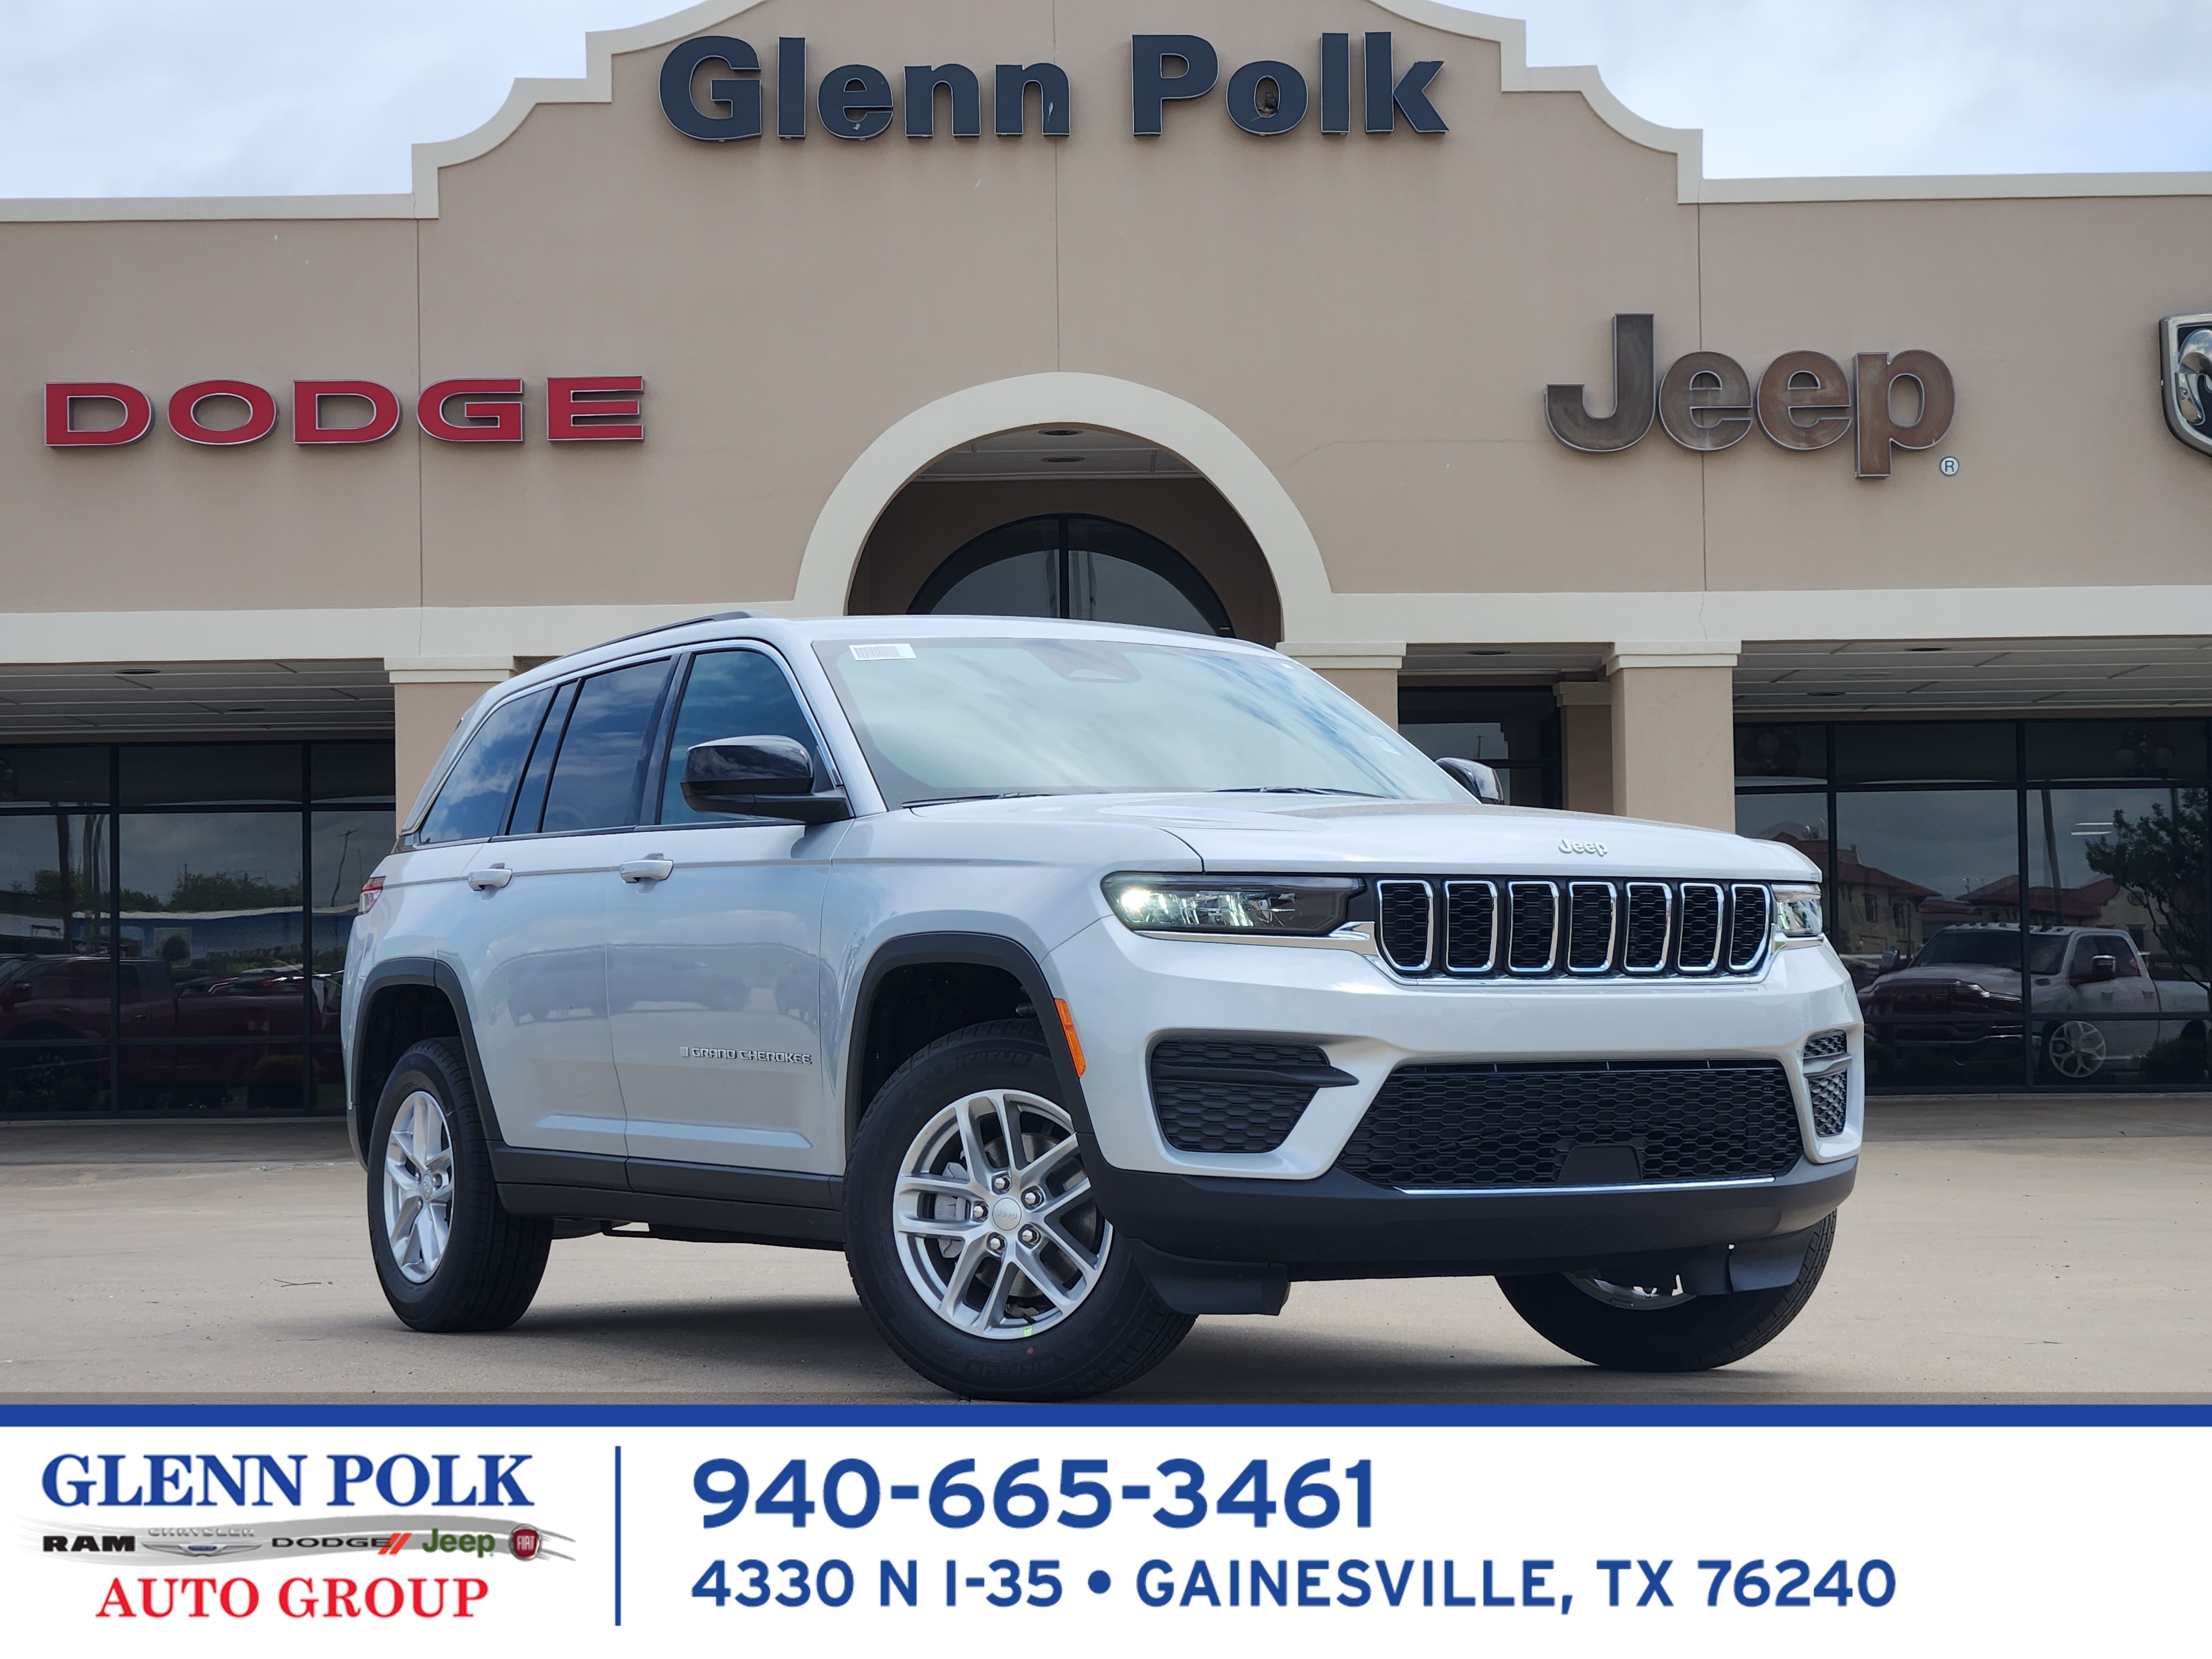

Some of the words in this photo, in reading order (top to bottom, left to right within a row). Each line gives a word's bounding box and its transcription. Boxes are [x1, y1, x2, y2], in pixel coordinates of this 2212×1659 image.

[659, 34, 1071, 142] Glenn
[1131, 31, 1449, 136] Polk
[44, 376, 644, 446] DODGE
[1544, 313, 1956, 478] Jeep
[1558, 838, 1608, 857] Jeep
[691, 1047, 738, 1059] GRAND
[740, 1050, 812, 1065] CHEROKEE
